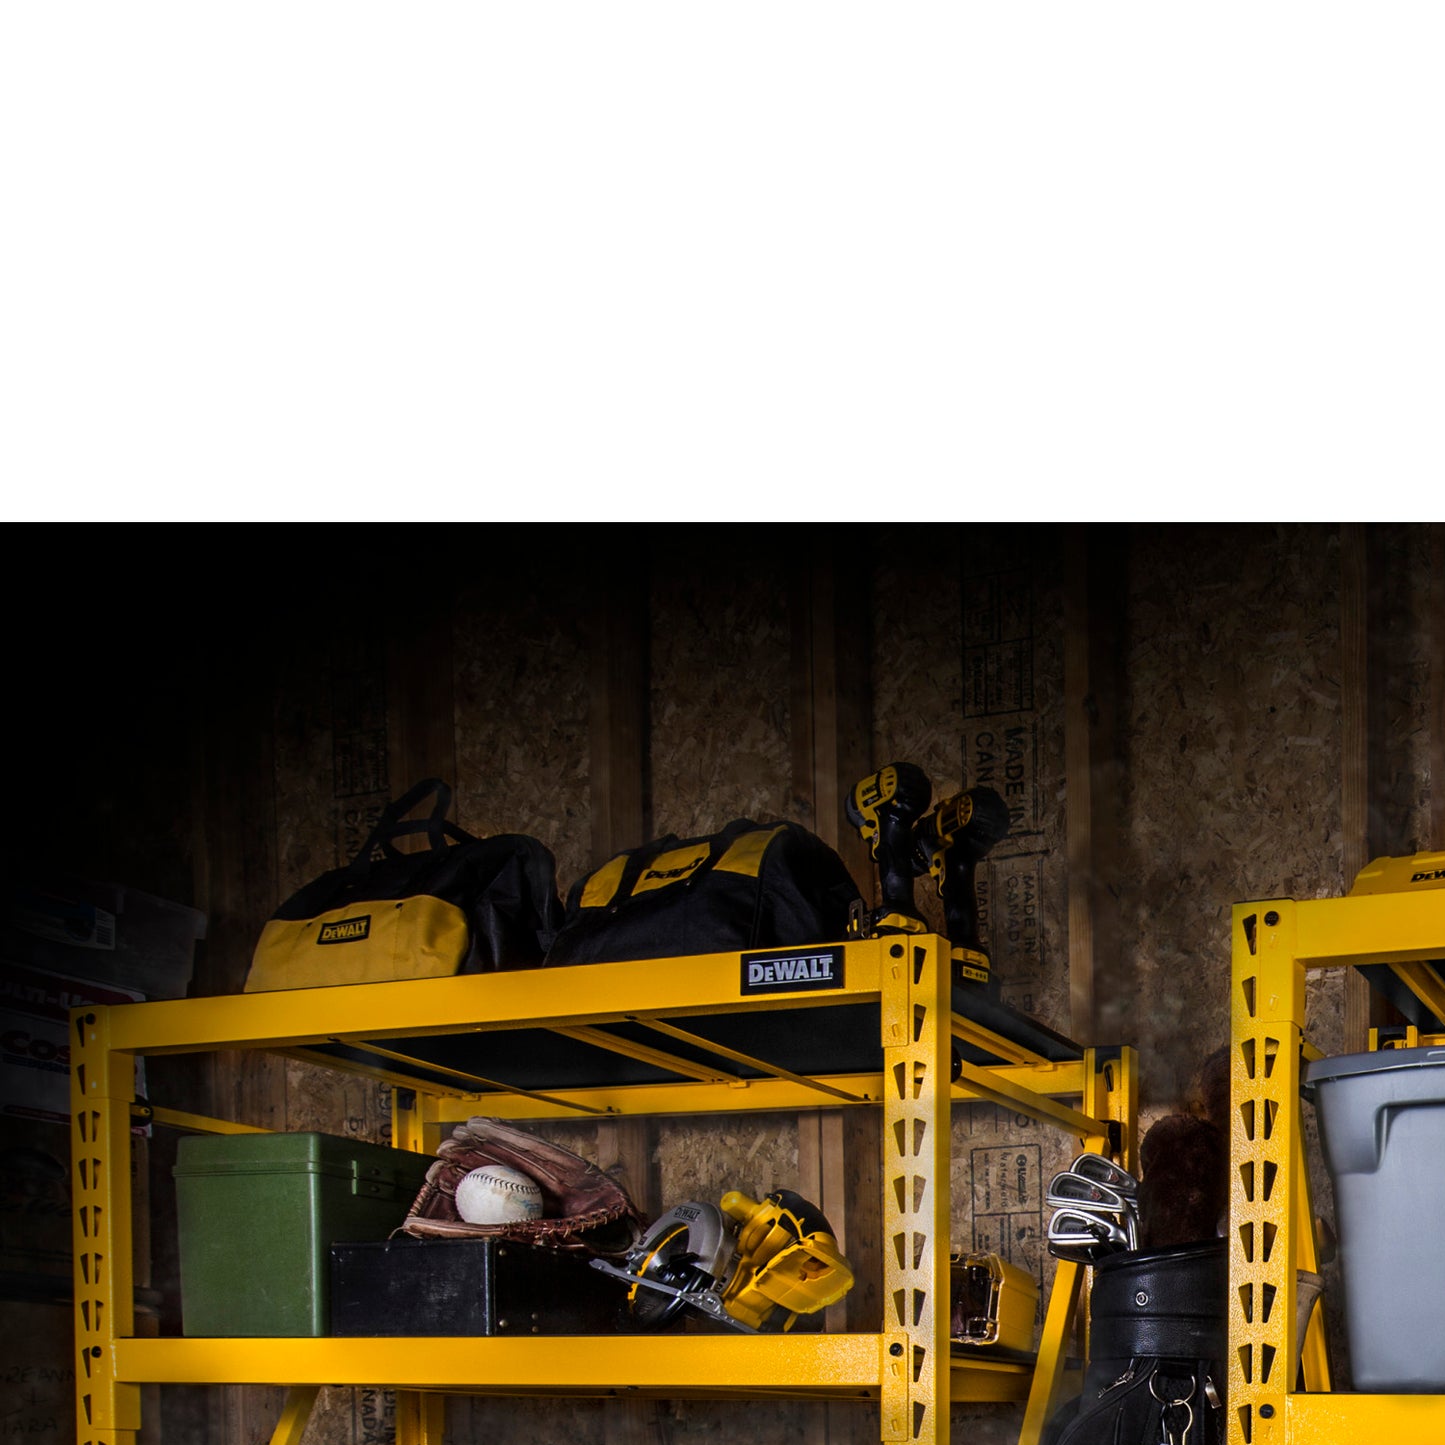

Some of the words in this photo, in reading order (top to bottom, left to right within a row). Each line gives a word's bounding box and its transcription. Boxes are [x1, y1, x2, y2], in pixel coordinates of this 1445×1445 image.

[1005, 726, 1025, 796] MADE
[1007, 876, 1019, 956] CANADA
[1023, 876, 1035, 928] MADE
[321, 920, 367, 939] DEWALT
[749, 957, 833, 982] DEWALT
[362, 1389, 376, 1445] NADA
